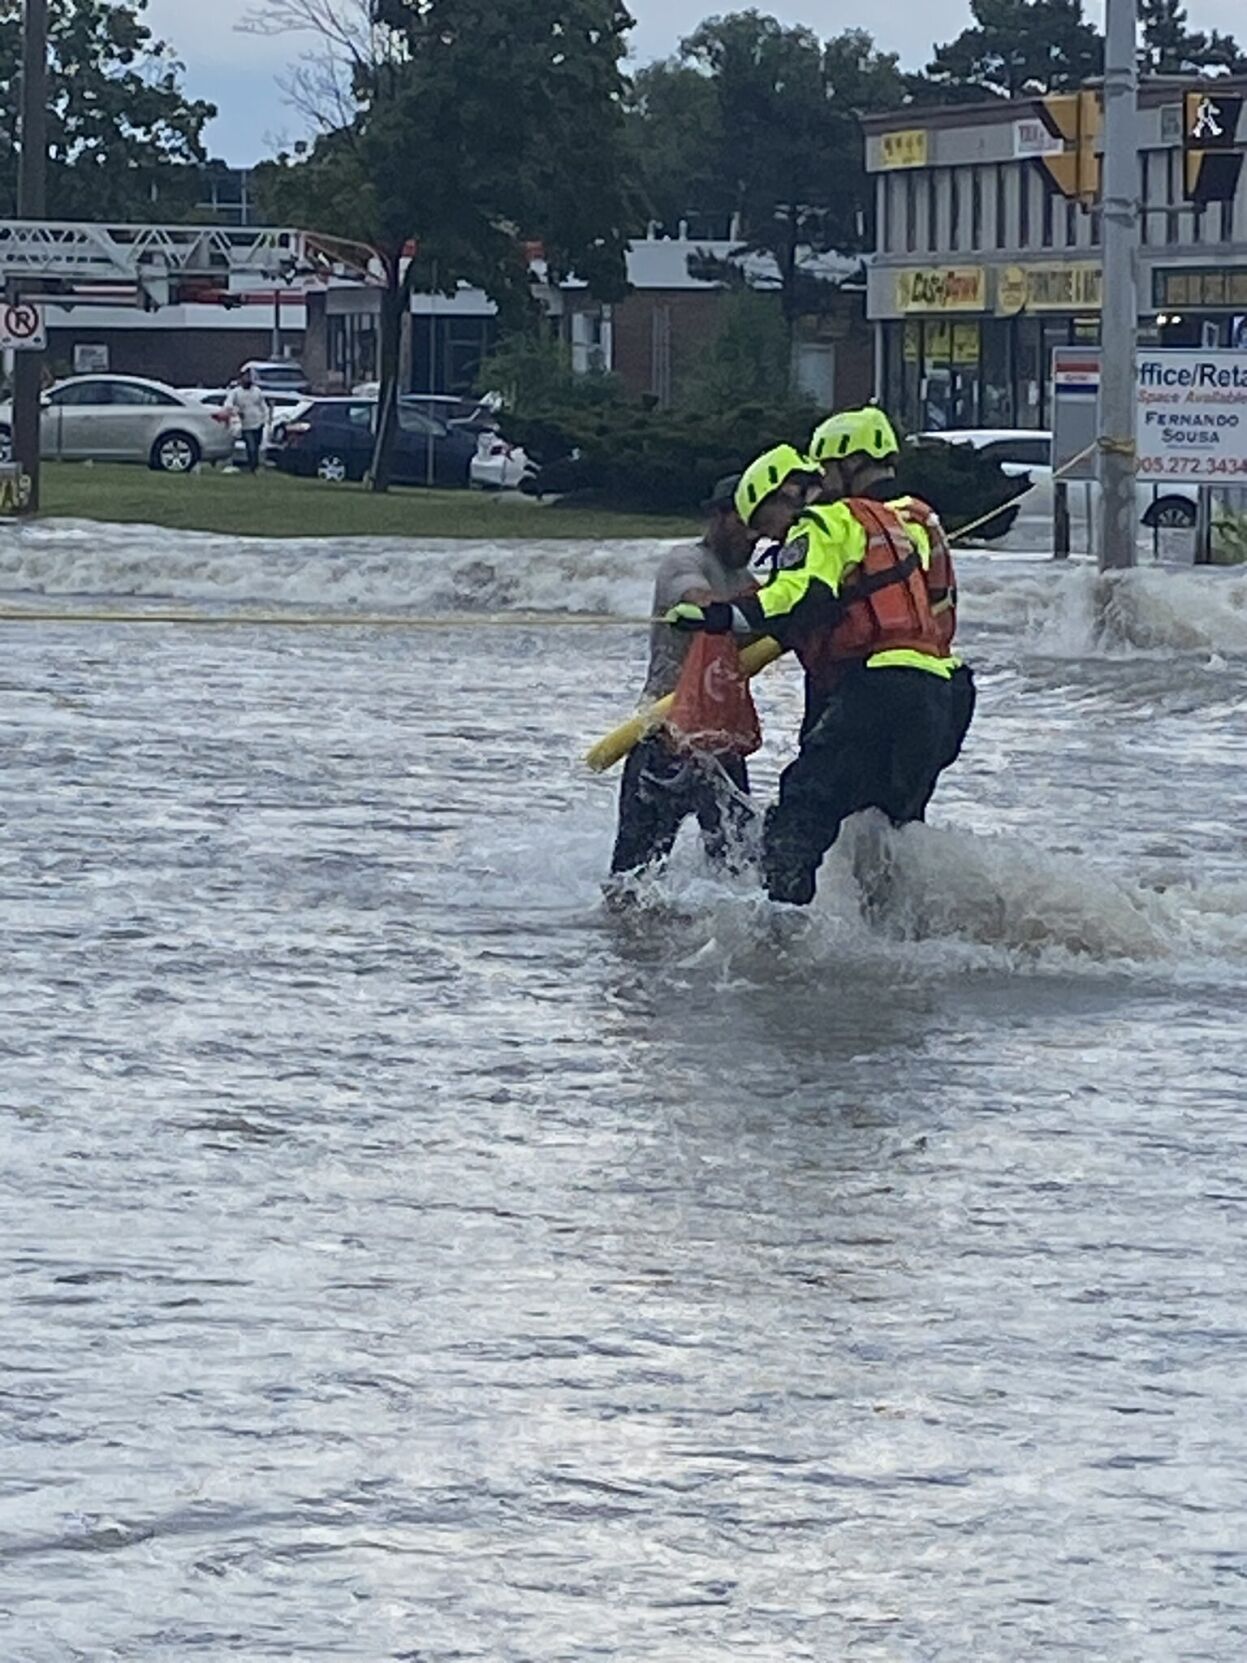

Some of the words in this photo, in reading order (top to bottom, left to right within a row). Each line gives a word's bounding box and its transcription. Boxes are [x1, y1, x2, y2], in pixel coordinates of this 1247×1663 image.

[1138, 390, 1180, 404] Space
[1144, 411, 1239, 428] FERNANDO
[1161, 427, 1220, 443] SOUSA
